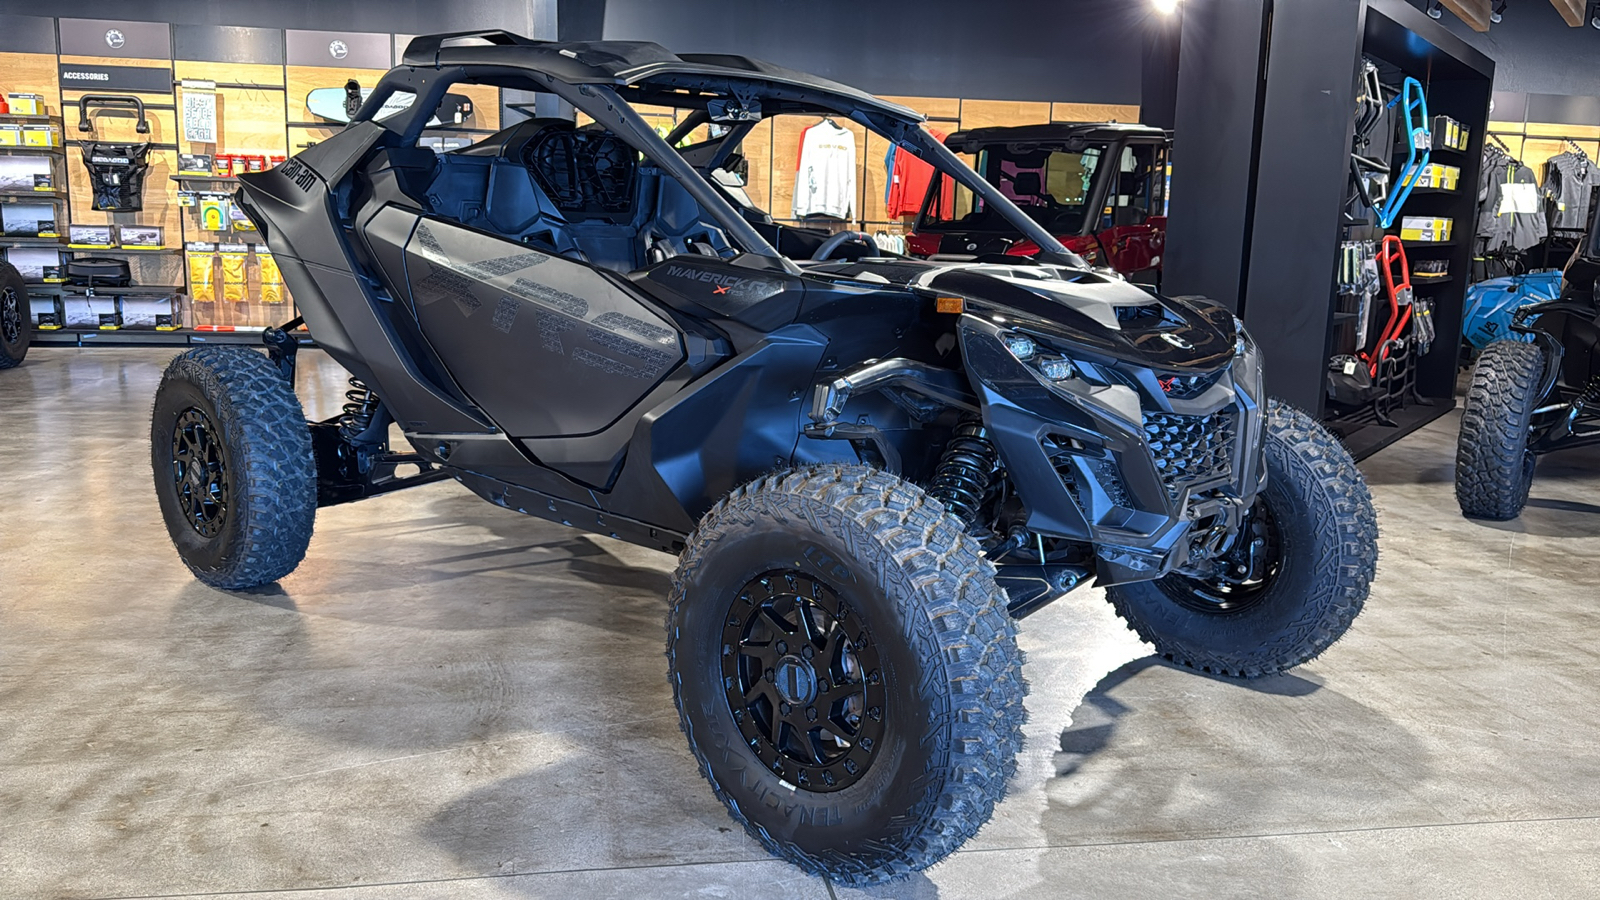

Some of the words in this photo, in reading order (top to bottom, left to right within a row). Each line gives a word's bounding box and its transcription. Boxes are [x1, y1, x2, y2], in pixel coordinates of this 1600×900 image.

[63, 71, 109, 81] ACCESSORIES
[281, 158, 317, 193] can-am
[667, 265, 749, 289] MAVERICK
